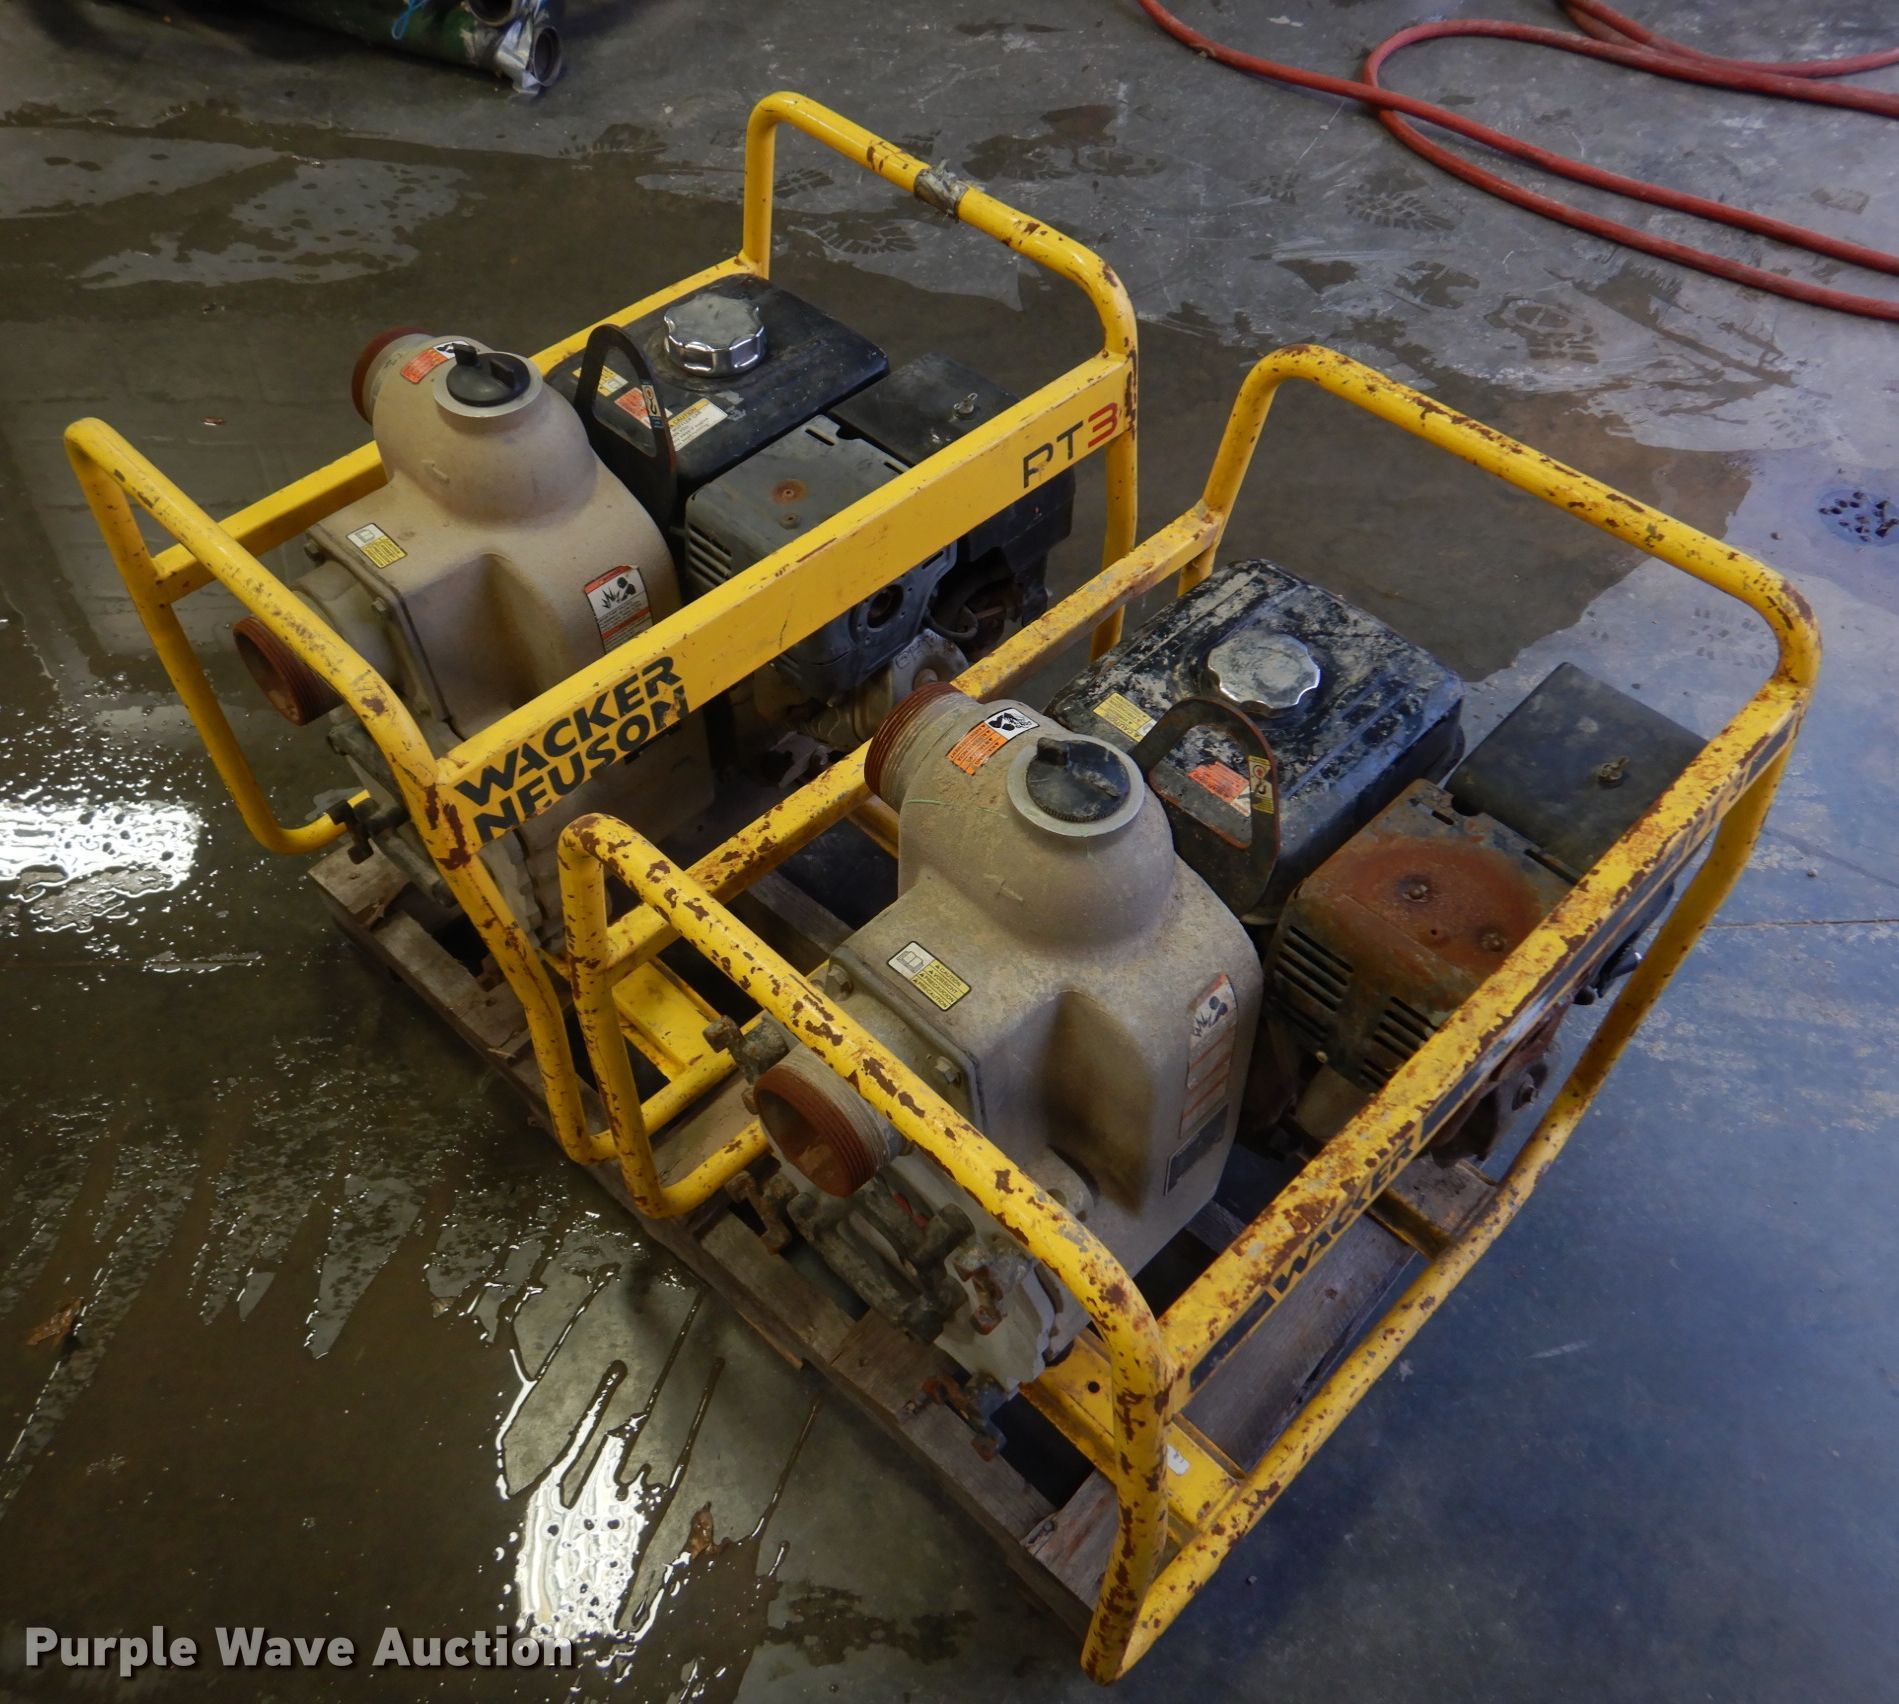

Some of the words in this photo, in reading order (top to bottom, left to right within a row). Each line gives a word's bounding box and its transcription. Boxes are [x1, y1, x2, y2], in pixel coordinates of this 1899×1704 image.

[1023, 402, 1118, 489] PT3
[454, 655, 684, 807] WACKER
[474, 684, 690, 844] NEUSON
[934, 973, 958, 994] VORSICHT
[939, 968, 961, 987] CAUTION
